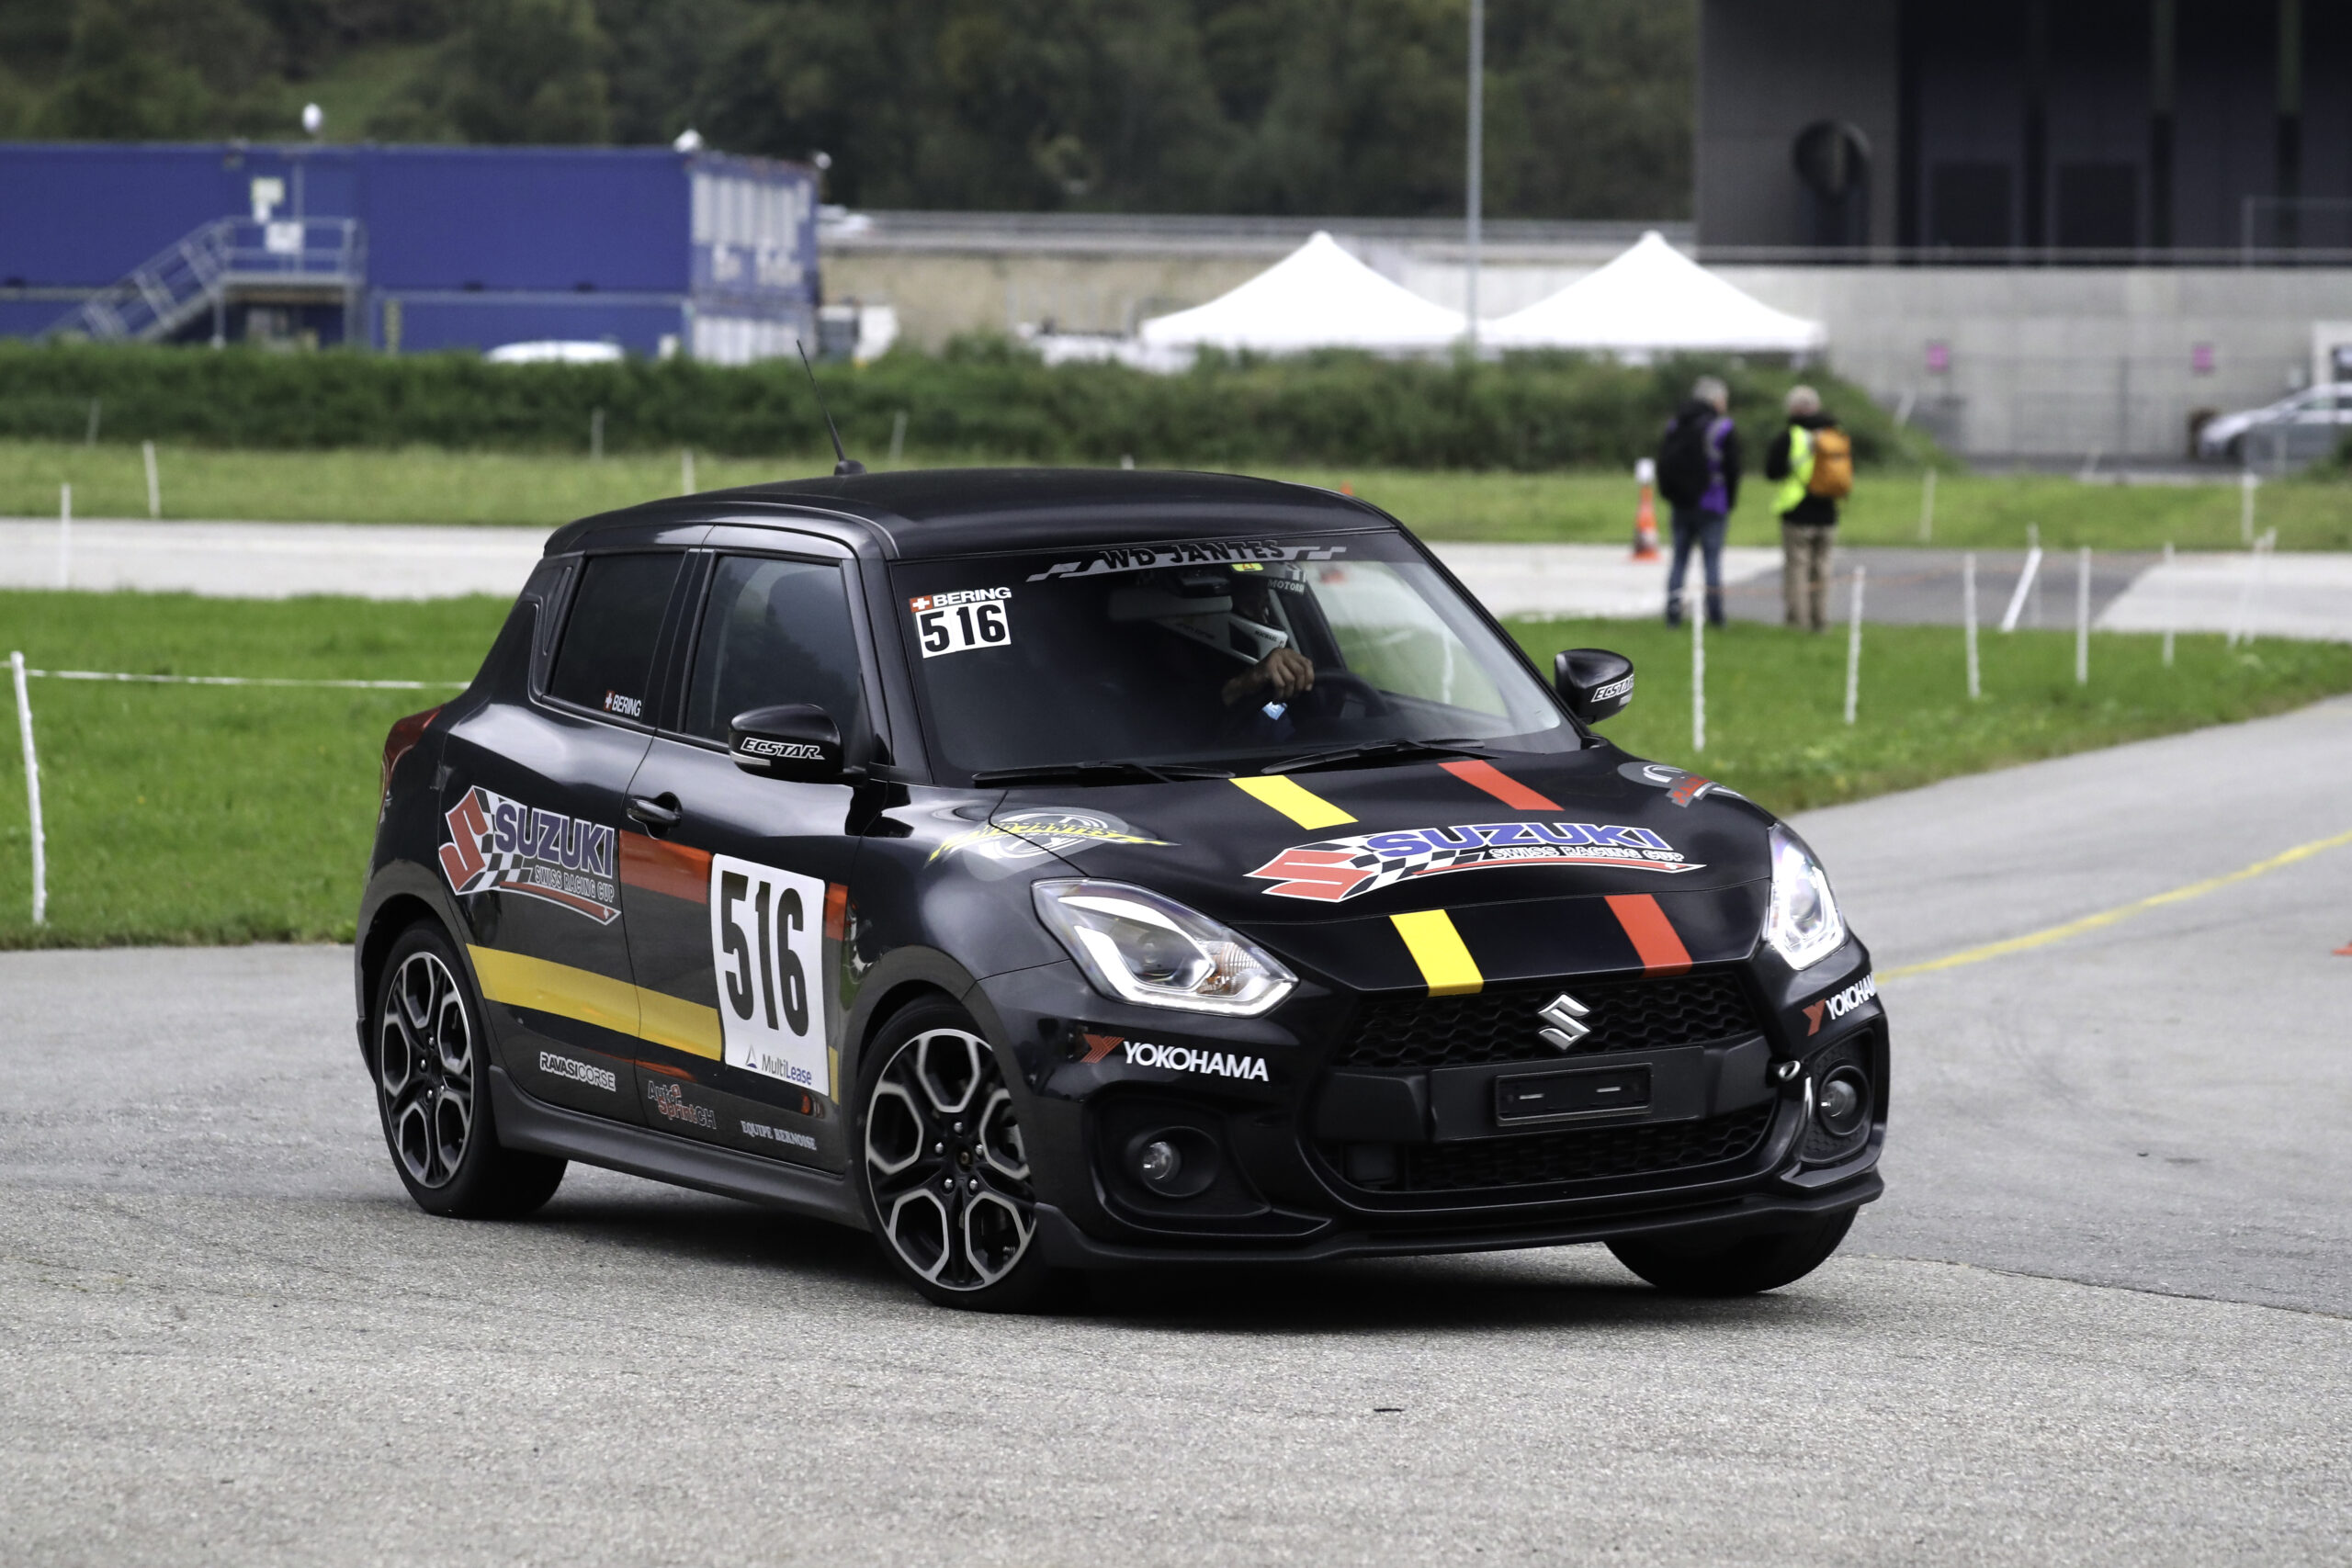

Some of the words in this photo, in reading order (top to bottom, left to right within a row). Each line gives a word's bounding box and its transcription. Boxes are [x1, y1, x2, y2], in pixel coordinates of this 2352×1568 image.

[1099, 548, 1156, 569] WD
[1170, 540, 1285, 563] JANTES
[933, 587, 1012, 607] BERING
[1268, 579, 1305, 594] MOTORS
[920, 604, 1006, 653] 516
[1590, 673, 1634, 703] ECSTA
[612, 694, 641, 717] BERING
[741, 737, 825, 761] ECSTAR
[494, 802, 615, 878] SUZUKI
[1365, 822, 1674, 858] SUZUKI
[1489, 847, 1559, 860] SWISS
[1562, 846, 1642, 860] RACING
[1643, 850, 1685, 863] CUP
[535, 864, 562, 889] SWISS
[563, 872, 595, 899] RACING
[597, 881, 615, 903] CUP
[721, 870, 809, 1037] 516
[1826, 972, 1876, 1020] YOKOHAM
[539, 1051, 616, 1092] RAVASICORSE
[761, 1054, 812, 1086] MultiLease
[1123, 1041, 1270, 1082] YOKOHAMA
[740, 1120, 774, 1140] EQUIPE
